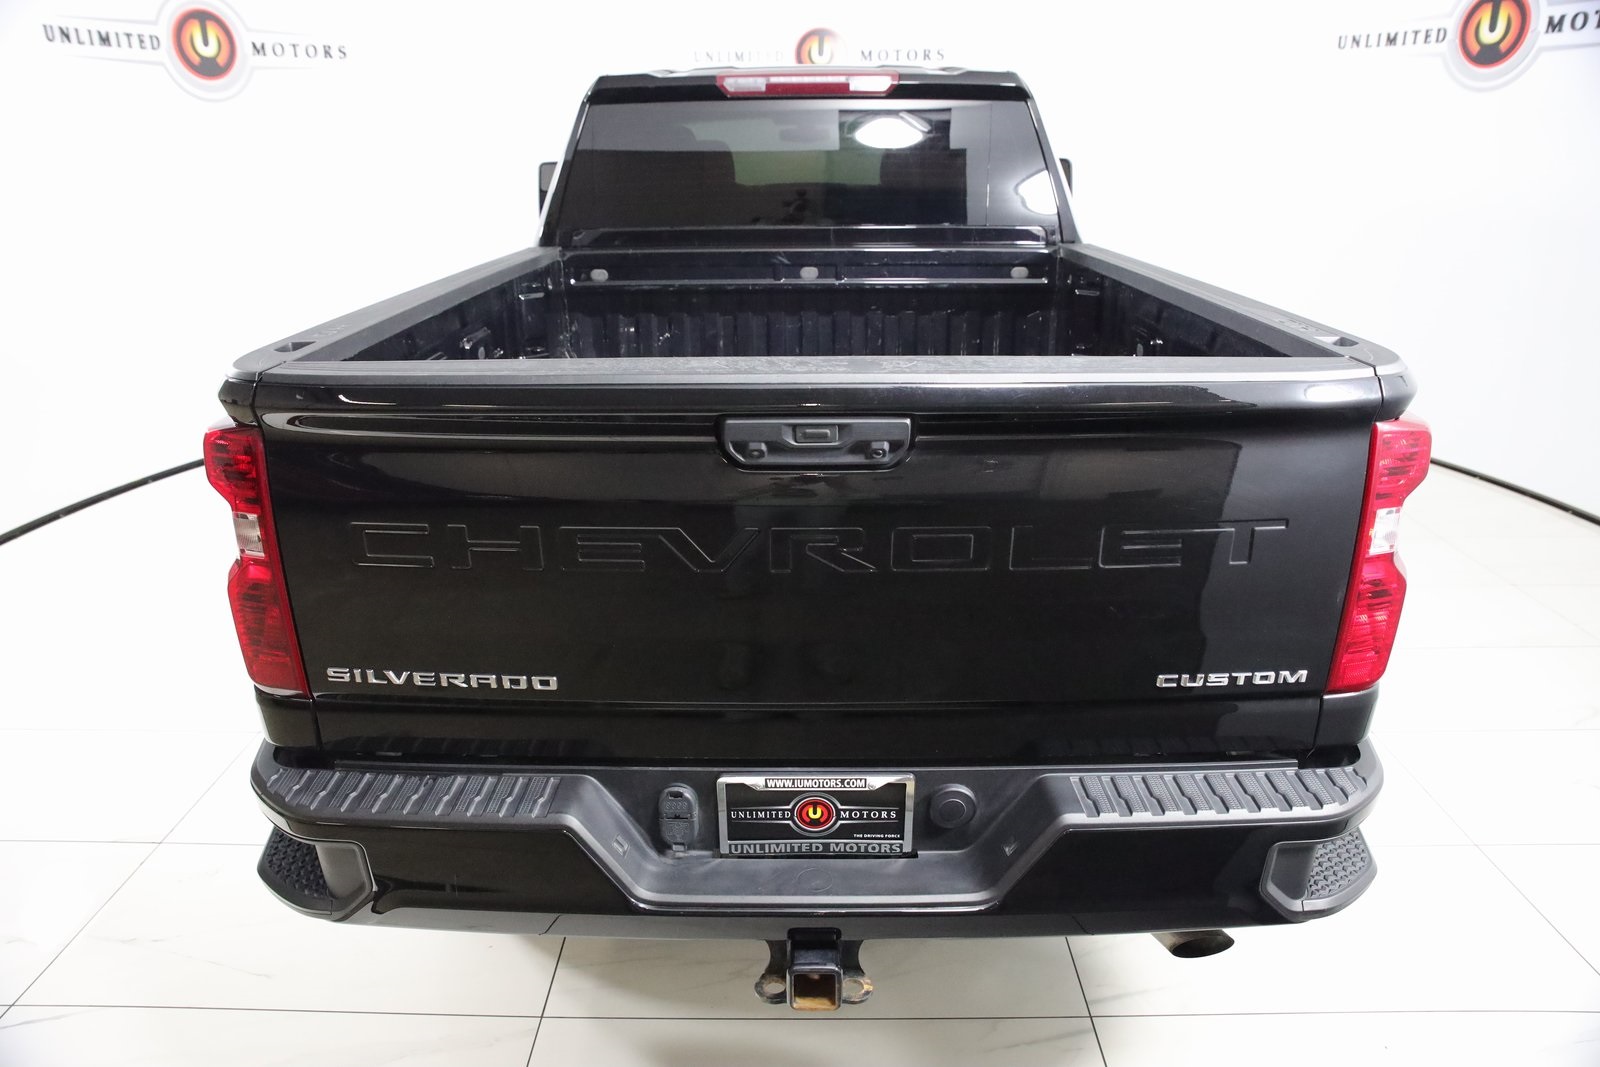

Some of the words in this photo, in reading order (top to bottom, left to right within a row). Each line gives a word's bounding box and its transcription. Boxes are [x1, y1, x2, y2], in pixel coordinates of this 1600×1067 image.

[42, 24, 161, 51] UNLIMITED
[251, 41, 348, 60] MOTORS
[1338, 27, 1447, 50] UNLIMITED
[694, 50, 784, 62] UNLIMITD
[860, 49, 946, 62] MOTORS
[349, 517, 1289, 574] CHEVROLET
[326, 667, 558, 691] SILVERADO
[1156, 669, 1308, 688] CUSTOM
[766, 778, 866, 789] WWW.IUMOTORS.COM
[731, 810, 791, 819] UNLIMITED
[840, 810, 897, 819] MOTORS
[730, 842, 823, 854] UNLIMITED
[829, 842, 900, 854] MOTORS
